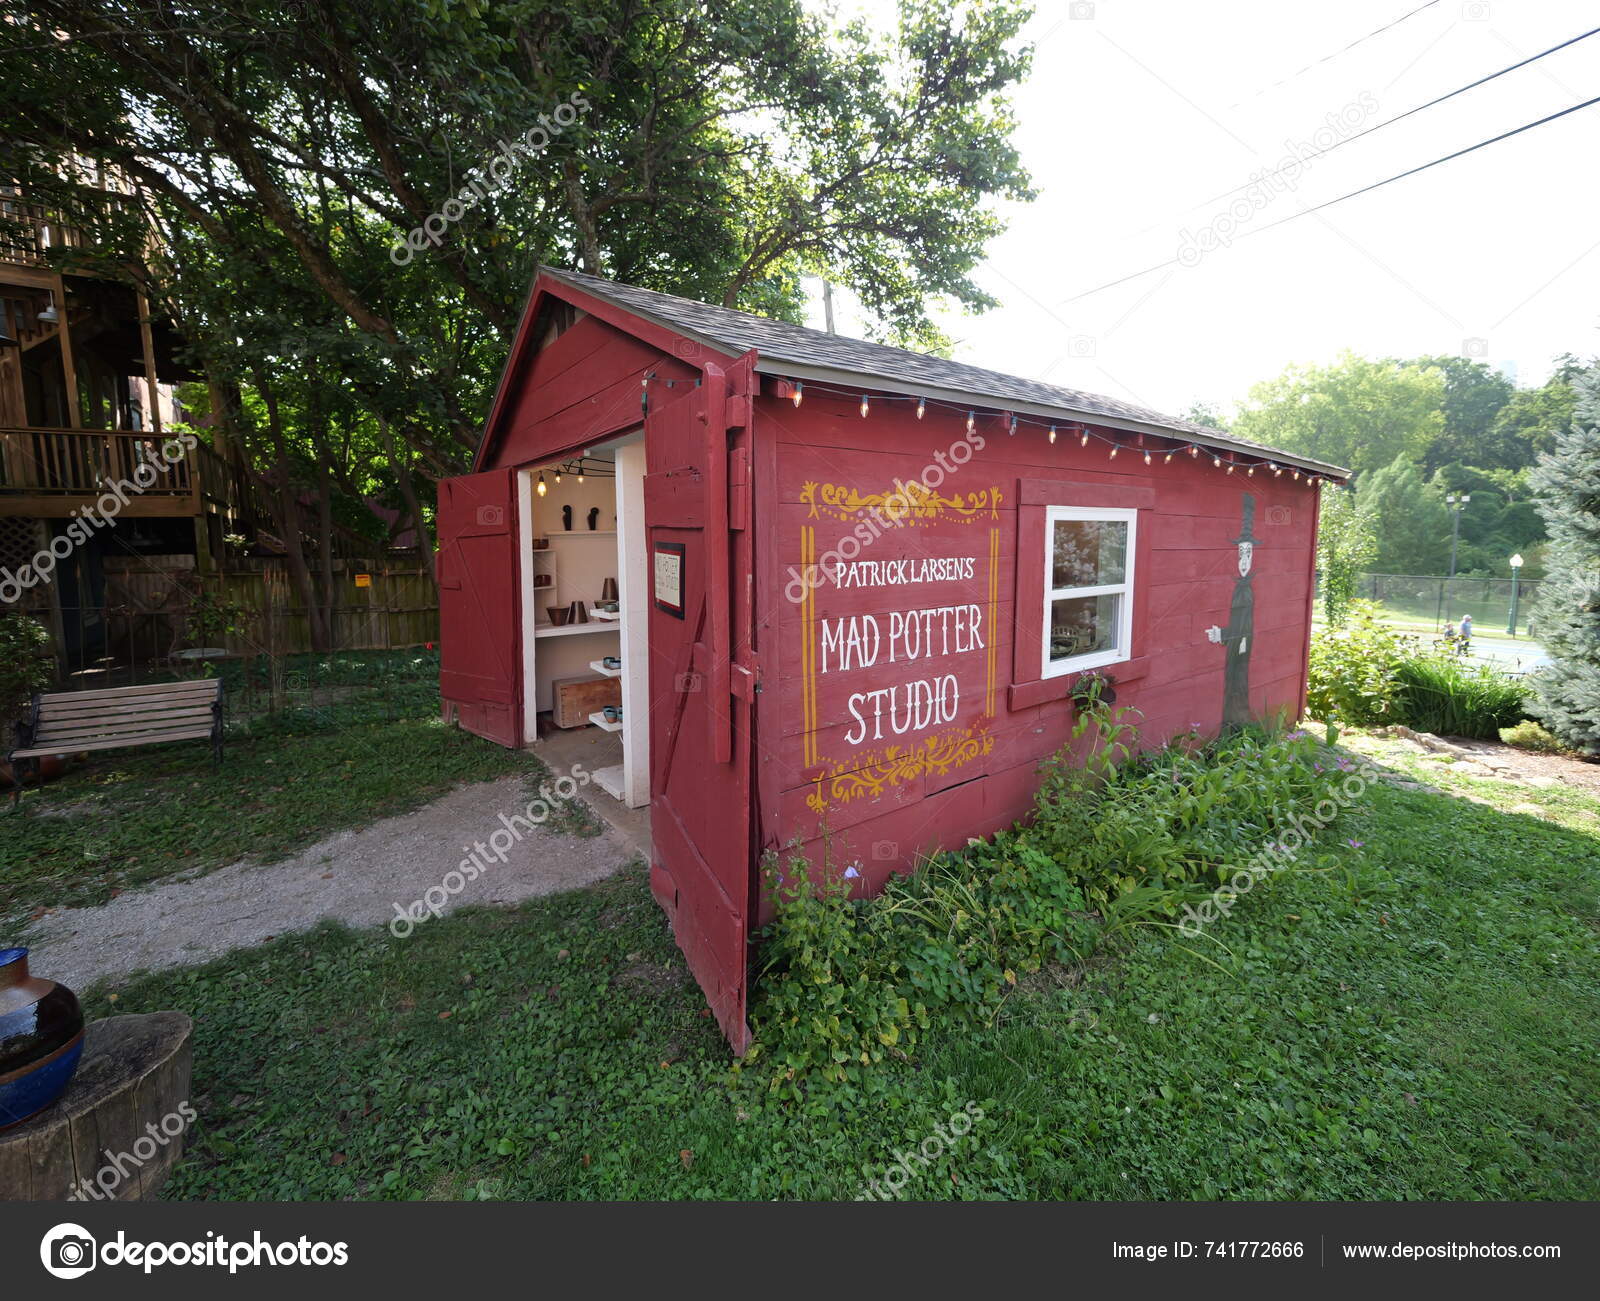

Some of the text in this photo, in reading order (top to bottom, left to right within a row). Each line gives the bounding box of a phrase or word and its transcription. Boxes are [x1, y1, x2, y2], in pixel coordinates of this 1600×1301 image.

[835, 557, 976, 589] PATRICK LARSEN'S
[821, 604, 985, 673] MAD POTTER
[844, 673, 960, 745] STUDIO
